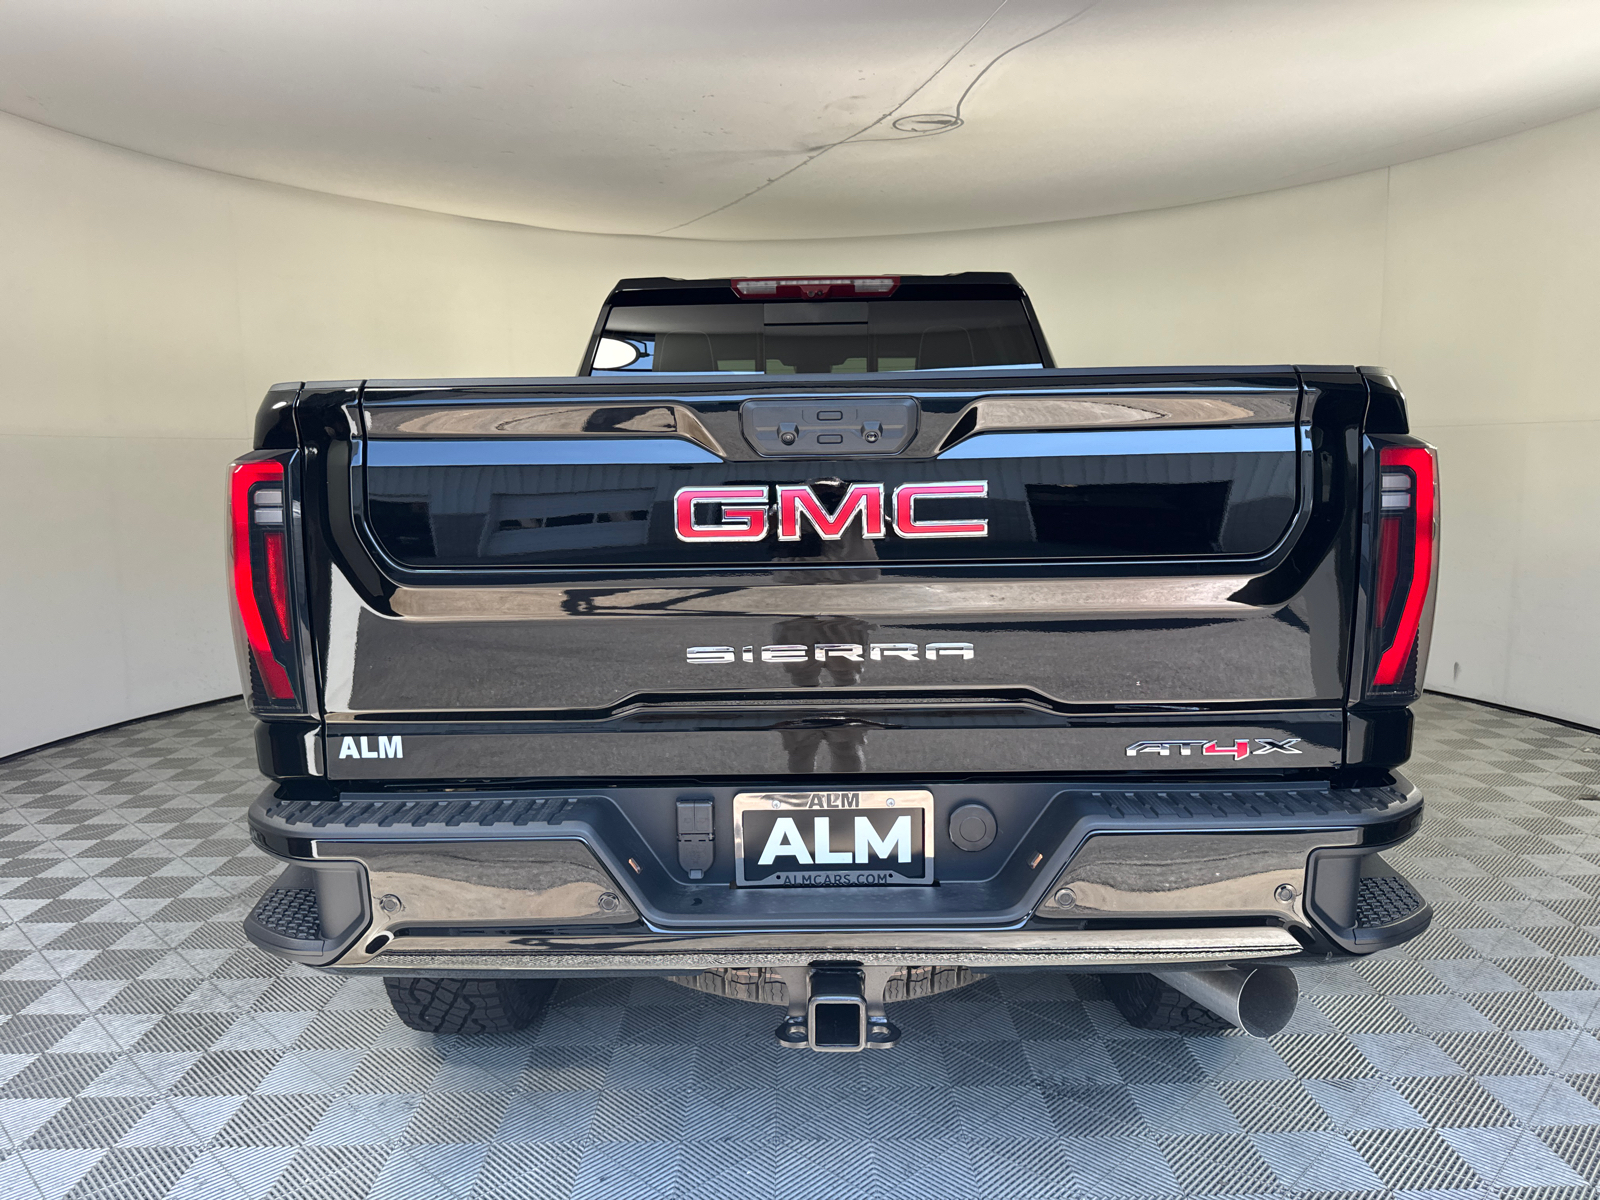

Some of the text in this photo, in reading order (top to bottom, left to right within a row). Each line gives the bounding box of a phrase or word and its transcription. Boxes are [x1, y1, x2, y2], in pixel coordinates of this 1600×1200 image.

[674, 480, 989, 543] GMC
[686, 642, 975, 664] SIERRA
[338, 735, 403, 759] ALM
[1125, 738, 1303, 761] AT4X
[808, 793, 860, 809] ALM
[757, 815, 912, 865] ALM
[783, 873, 888, 886] ALMCARS.COM
